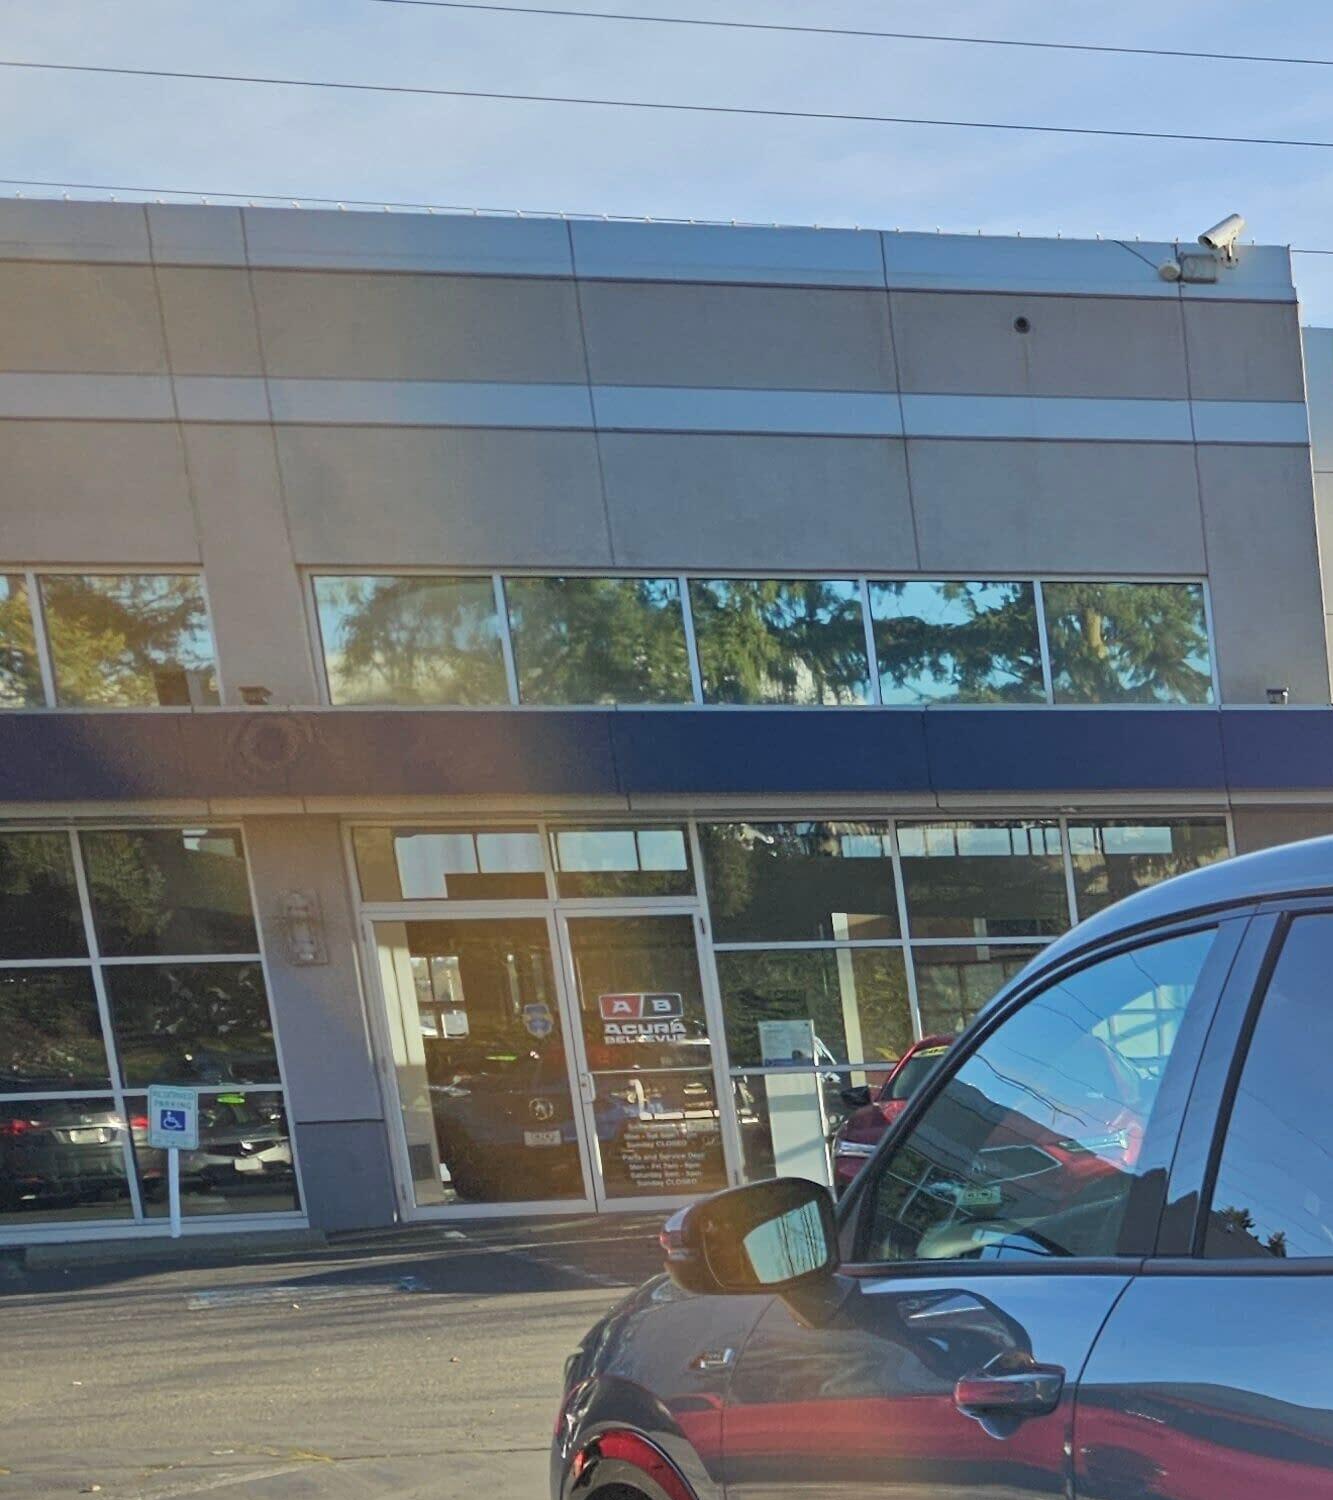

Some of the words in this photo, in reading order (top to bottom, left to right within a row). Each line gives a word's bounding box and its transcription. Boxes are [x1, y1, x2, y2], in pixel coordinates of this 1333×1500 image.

[612, 1000, 632, 1013] A
[652, 999, 672, 1012] B
[604, 1022, 686, 1035] ACURA
